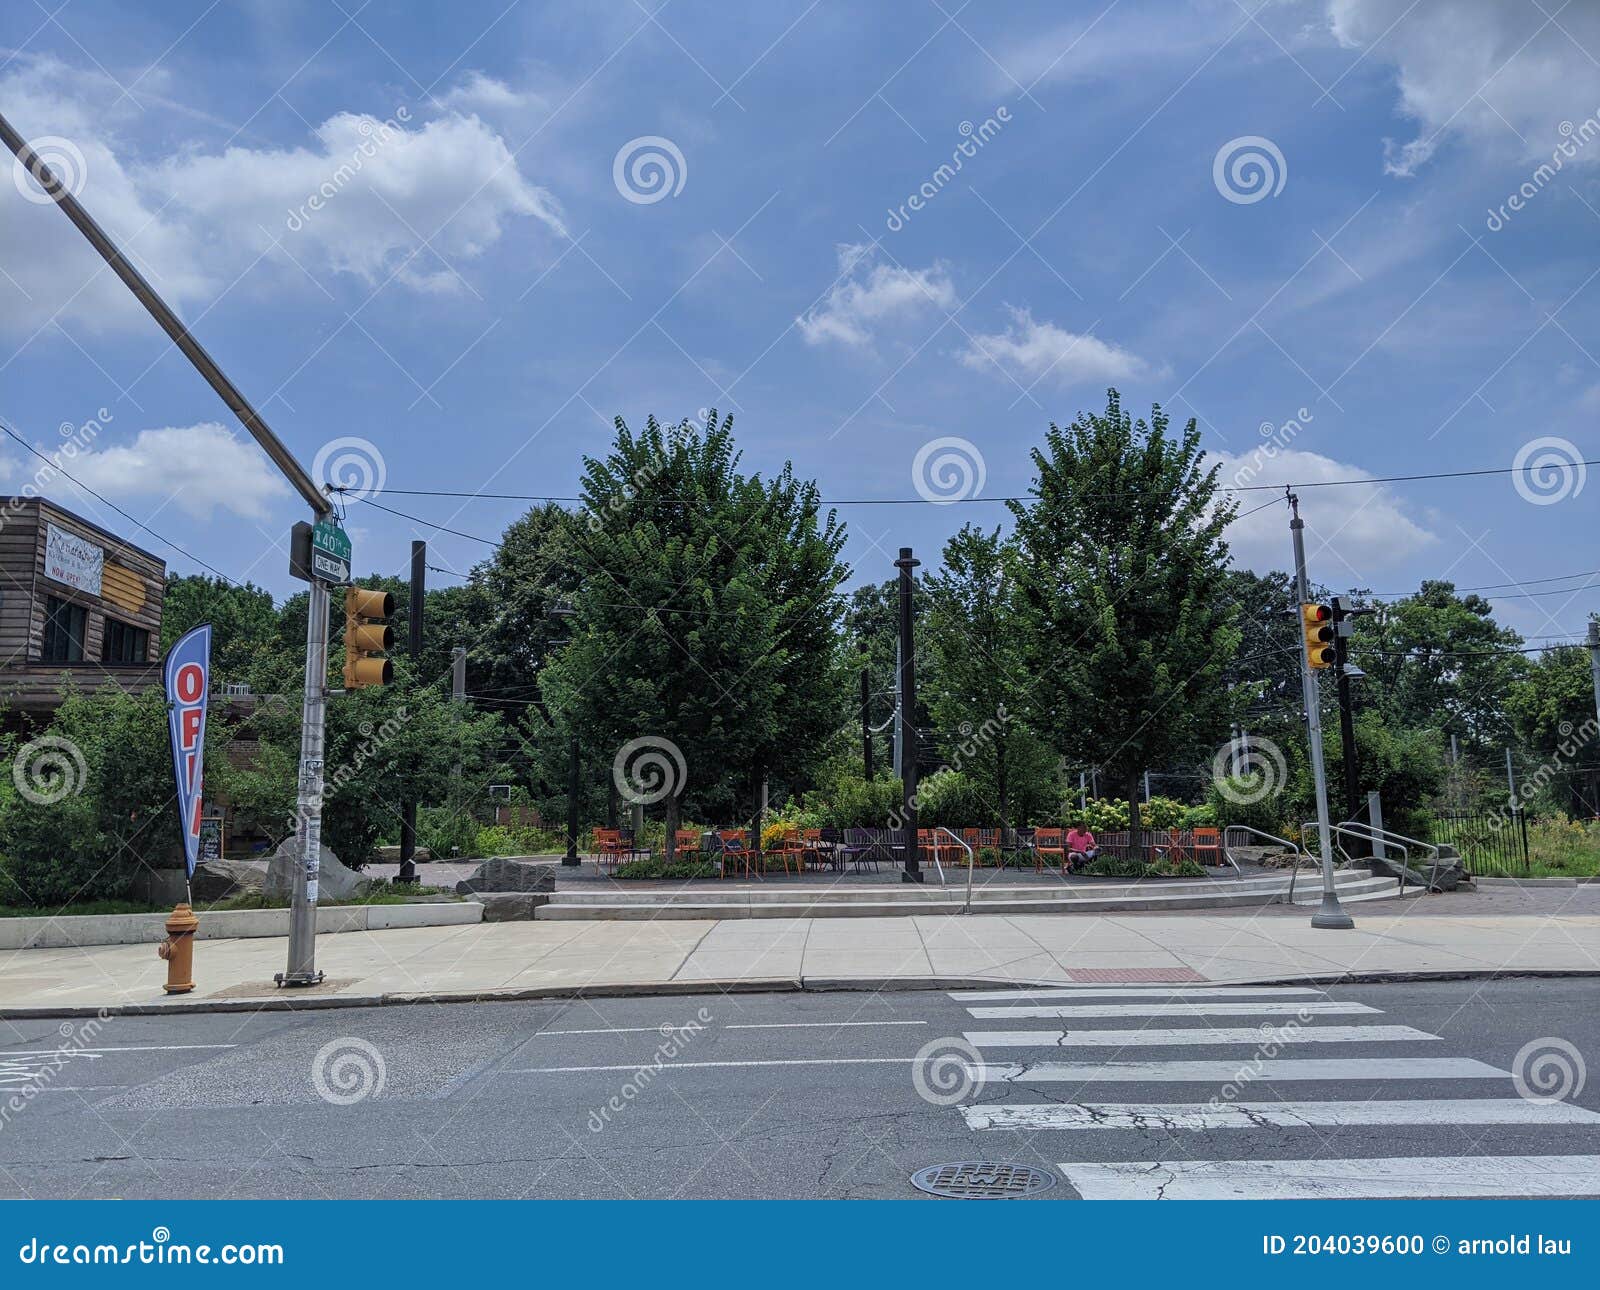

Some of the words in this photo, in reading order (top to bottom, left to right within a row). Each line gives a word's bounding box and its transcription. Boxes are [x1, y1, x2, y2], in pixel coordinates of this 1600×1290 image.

[52, 567, 65, 578] NOW
[317, 556, 329, 571] ONE
[330, 563, 341, 577] WAY
